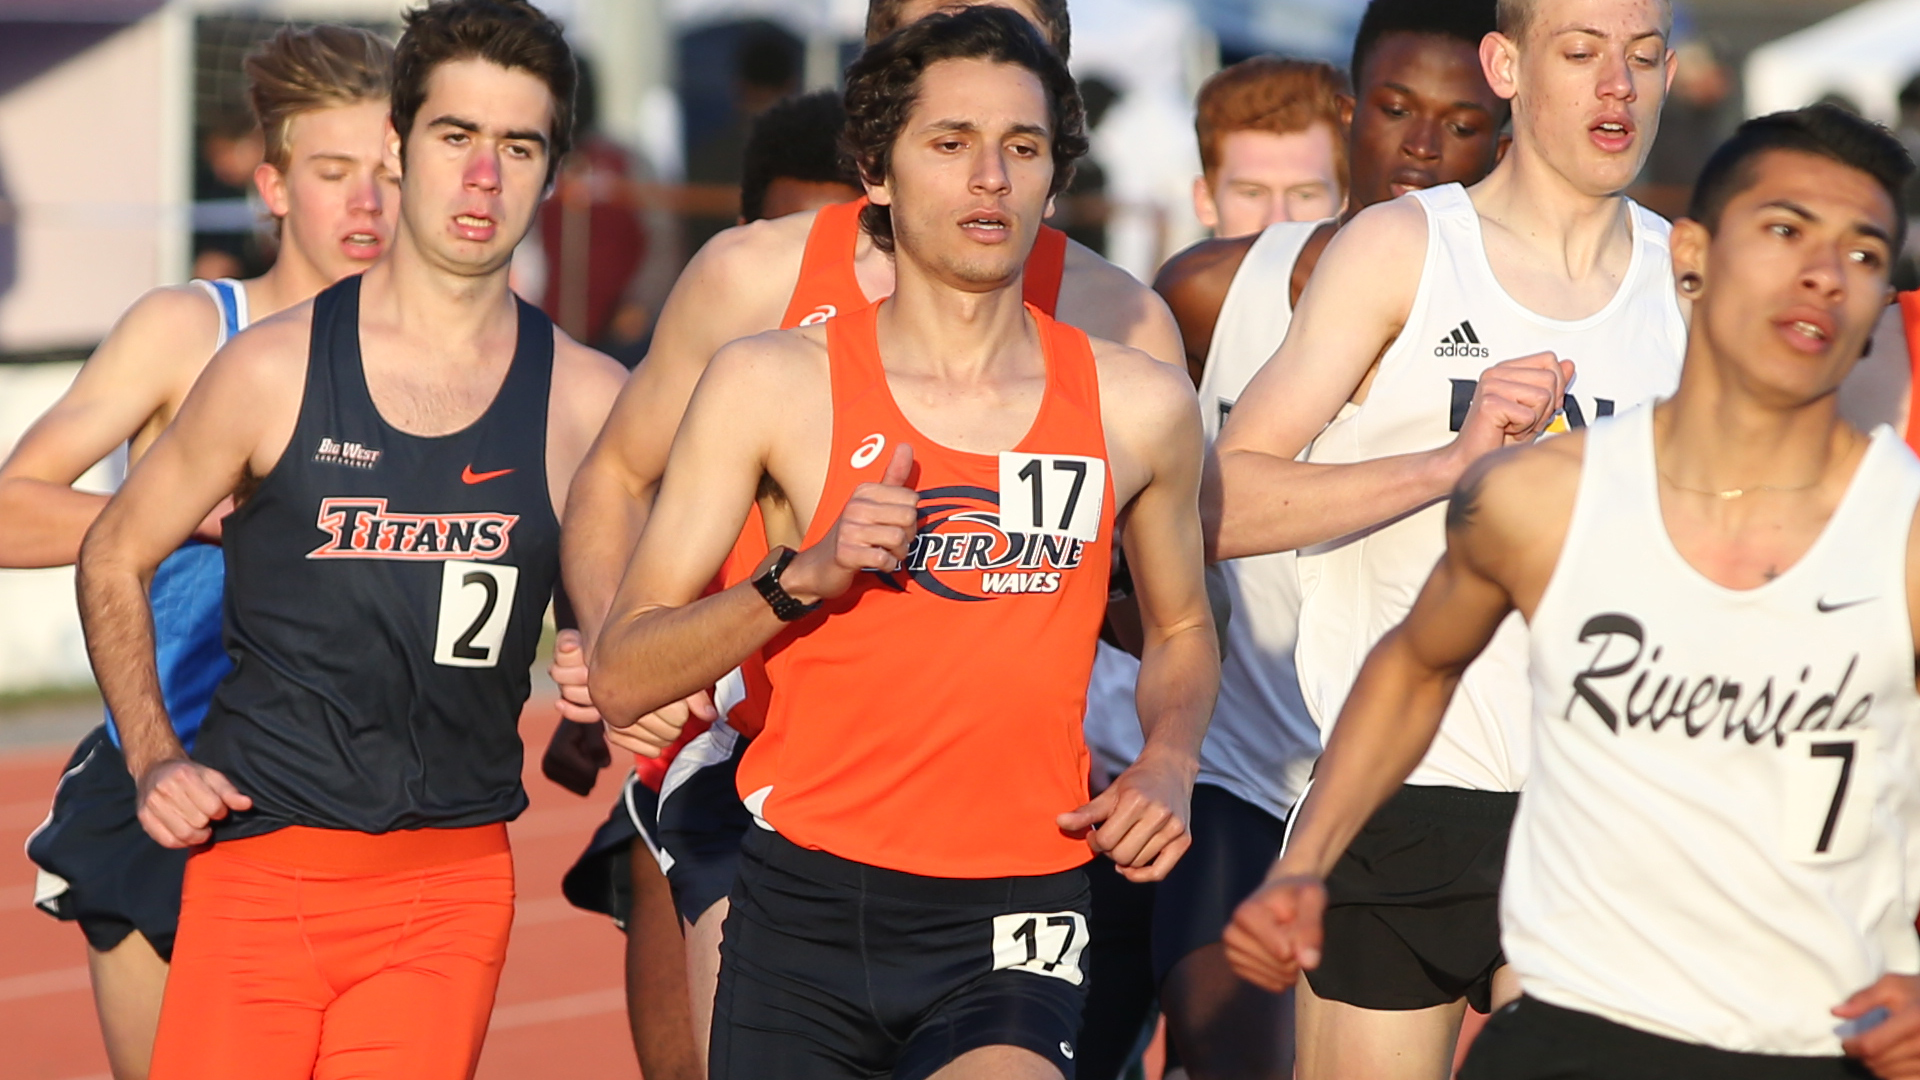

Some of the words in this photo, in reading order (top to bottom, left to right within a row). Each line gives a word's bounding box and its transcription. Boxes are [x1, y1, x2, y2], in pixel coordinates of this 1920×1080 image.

[1434, 342, 1490, 359] adidas
[318, 437, 342, 456] BIG
[342, 441, 383, 463] WEST
[1017, 458, 1088, 531] 17
[305, 497, 520, 561] TITANS
[861, 530, 1087, 571] PPERDINE
[981, 572, 1061, 594] WAVES
[451, 570, 499, 661] 2
[1563, 611, 1875, 748] Riverside
[1810, 740, 1858, 854] 7
[1012, 916, 1077, 973] 17
